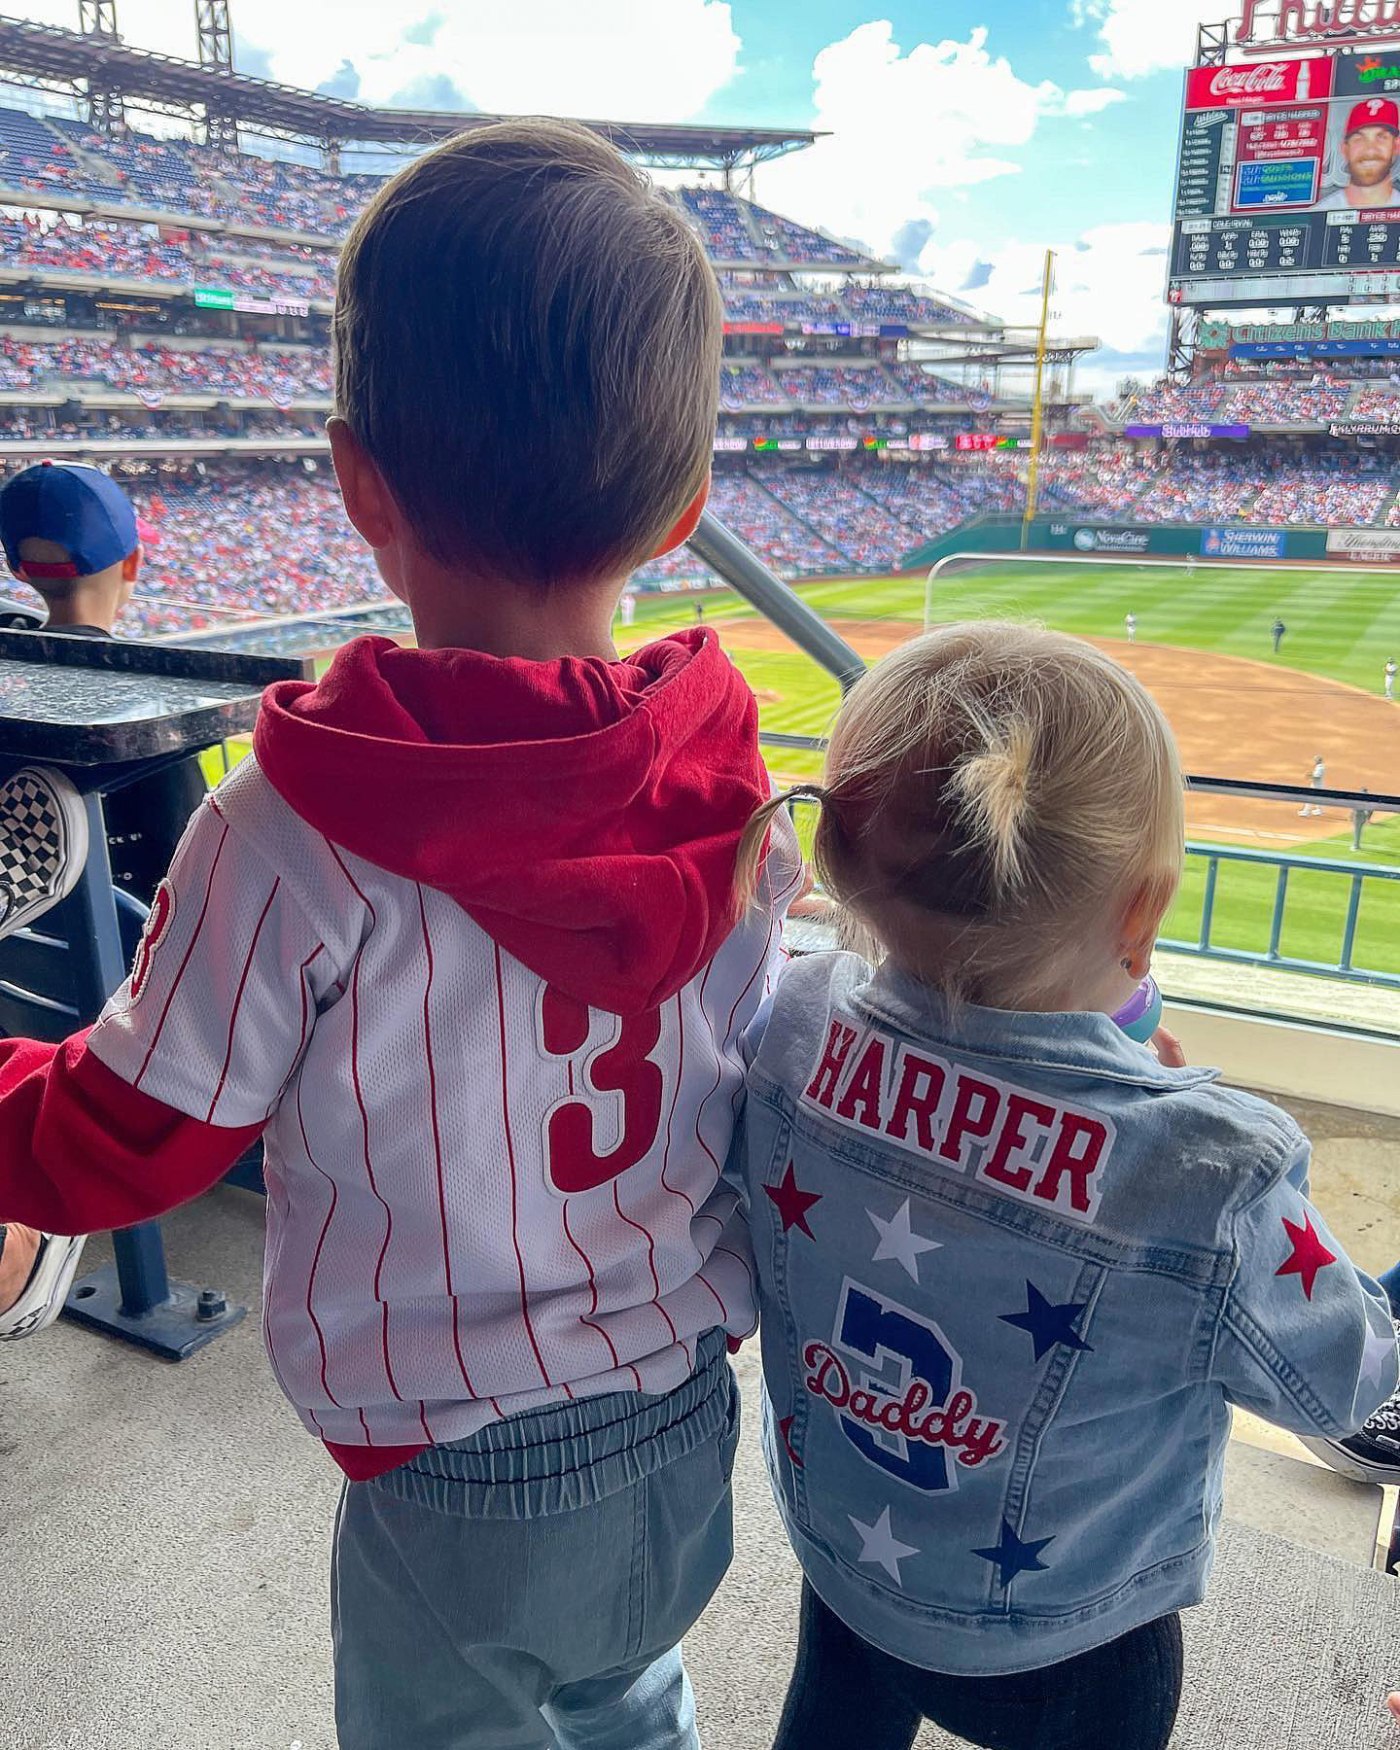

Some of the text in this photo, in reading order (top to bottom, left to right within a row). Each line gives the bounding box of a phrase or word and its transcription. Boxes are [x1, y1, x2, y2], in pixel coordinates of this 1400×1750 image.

[1231, 324, 1326, 342] Citizens
[1327, 321, 1388, 340] Bank
[538, 982, 662, 1194] 3
[804, 1016, 1110, 1215] HARPER
[803, 1341, 1006, 1467] Daddy
[835, 1278, 959, 1494] 3
